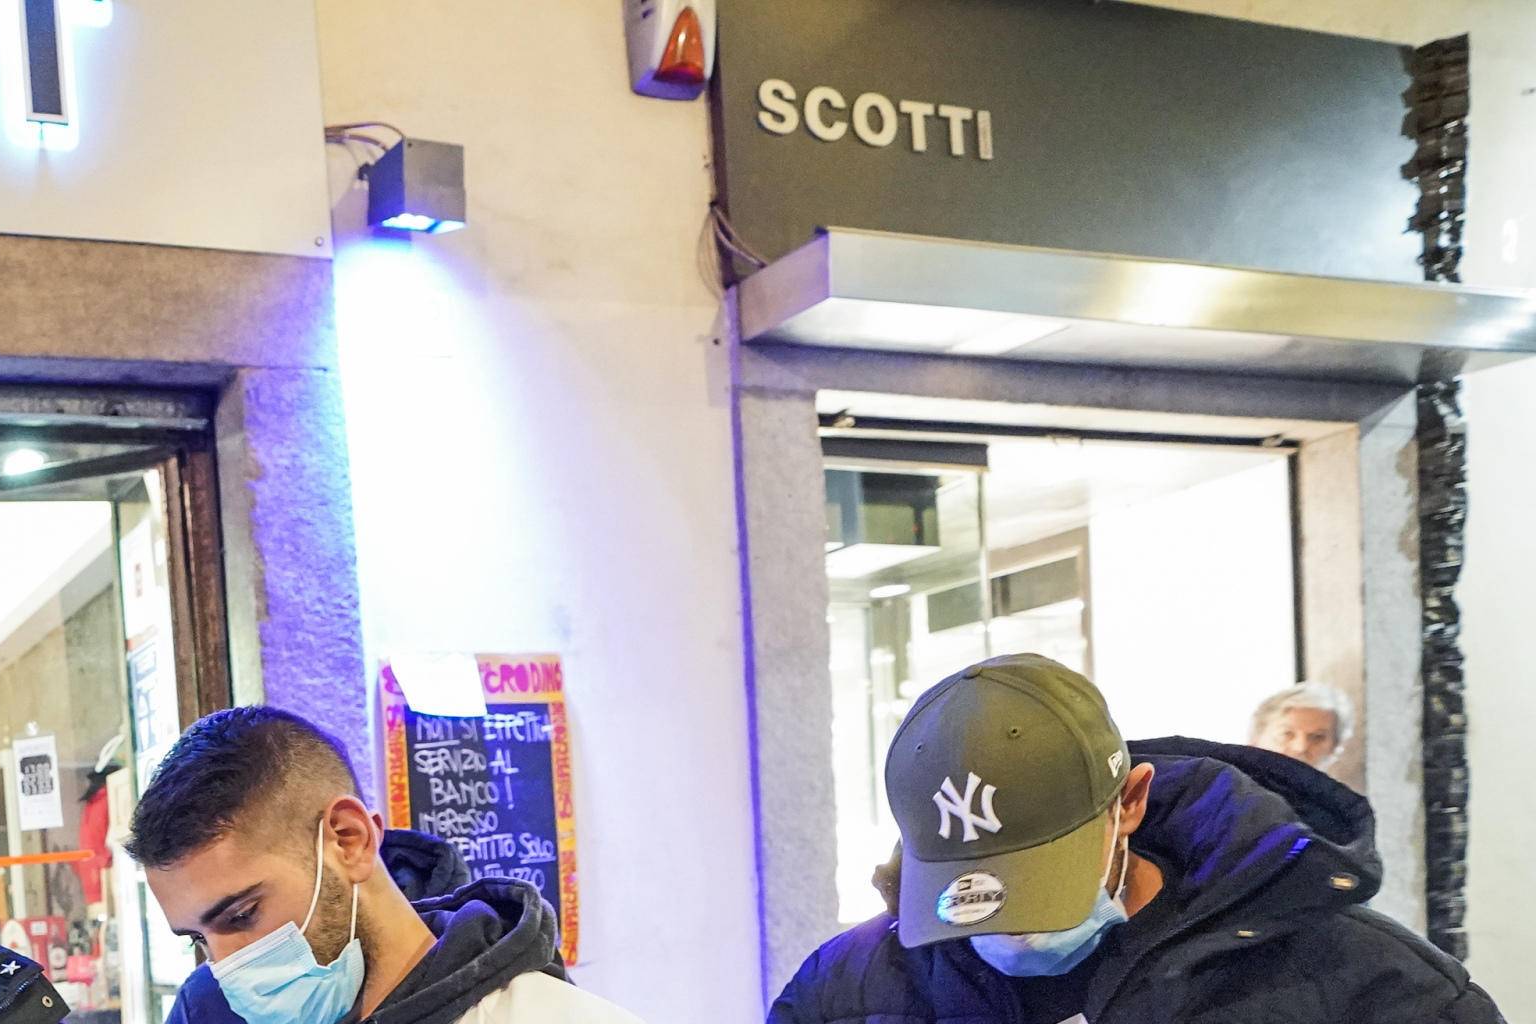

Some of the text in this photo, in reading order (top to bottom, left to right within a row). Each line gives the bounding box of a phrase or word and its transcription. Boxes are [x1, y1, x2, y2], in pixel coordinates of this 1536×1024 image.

[758, 78, 994, 160] SCOTTI
[414, 748, 520, 776] SERVIZIO AL
[418, 808, 499, 837] INGRESSO
